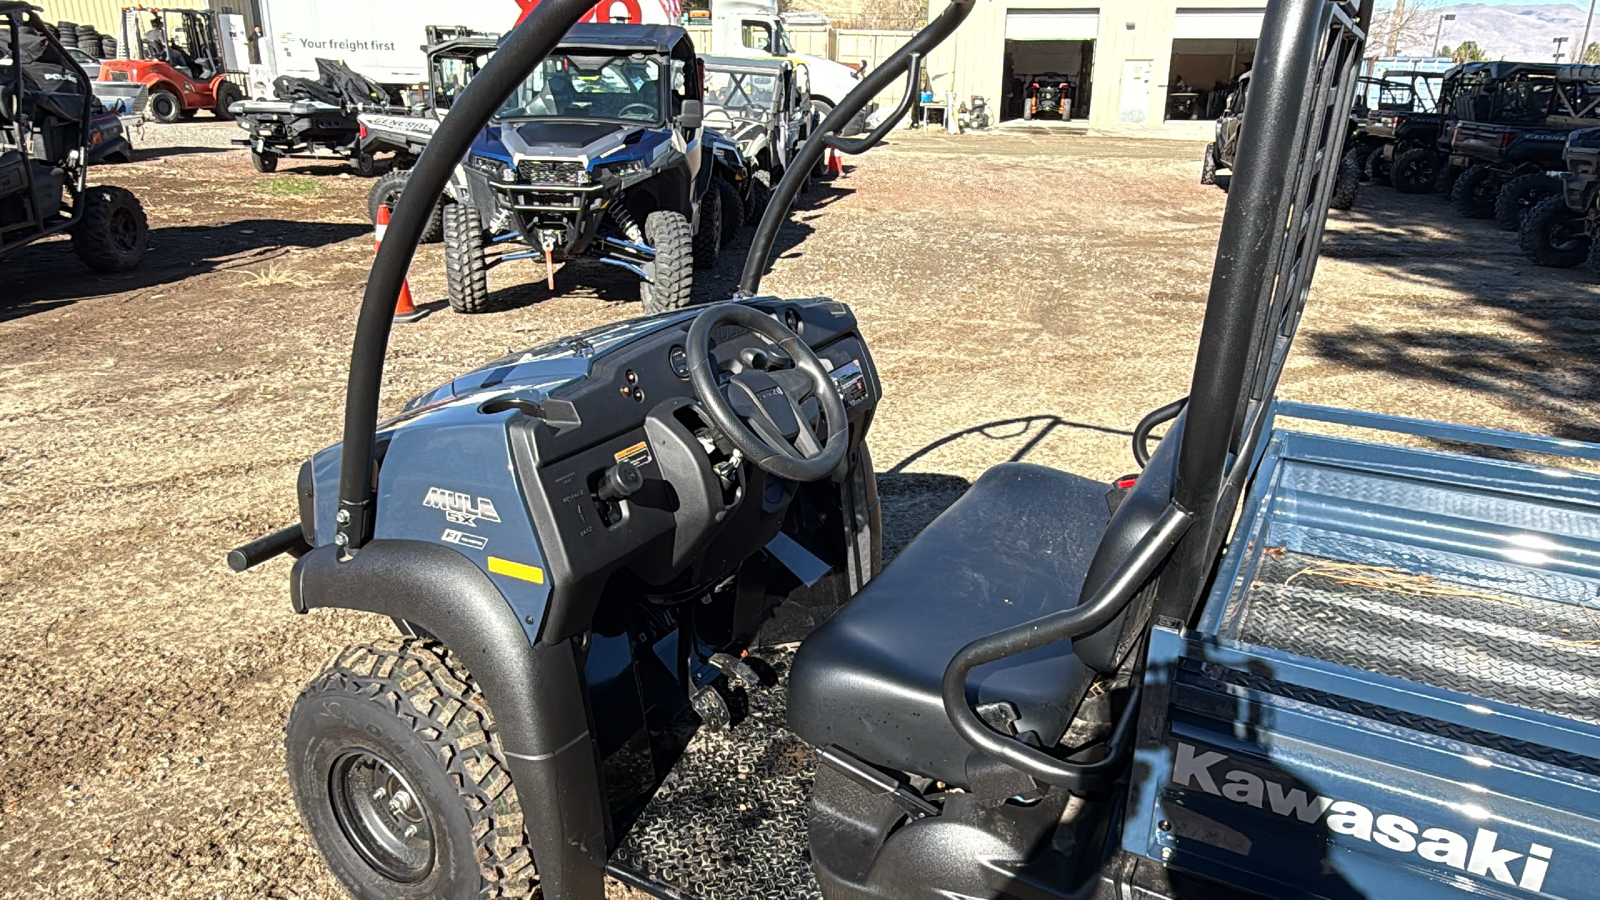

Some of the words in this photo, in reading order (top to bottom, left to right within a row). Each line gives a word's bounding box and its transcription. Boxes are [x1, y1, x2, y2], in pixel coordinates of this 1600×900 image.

[299, 38, 326, 49] Your
[329, 39, 369, 52] freight
[371, 40, 395, 51] first
[373, 117, 430, 132] GENERAL
[423, 487, 501, 522] MULE
[446, 511, 477, 527] SX
[1172, 742, 1553, 893] Kawasaki
